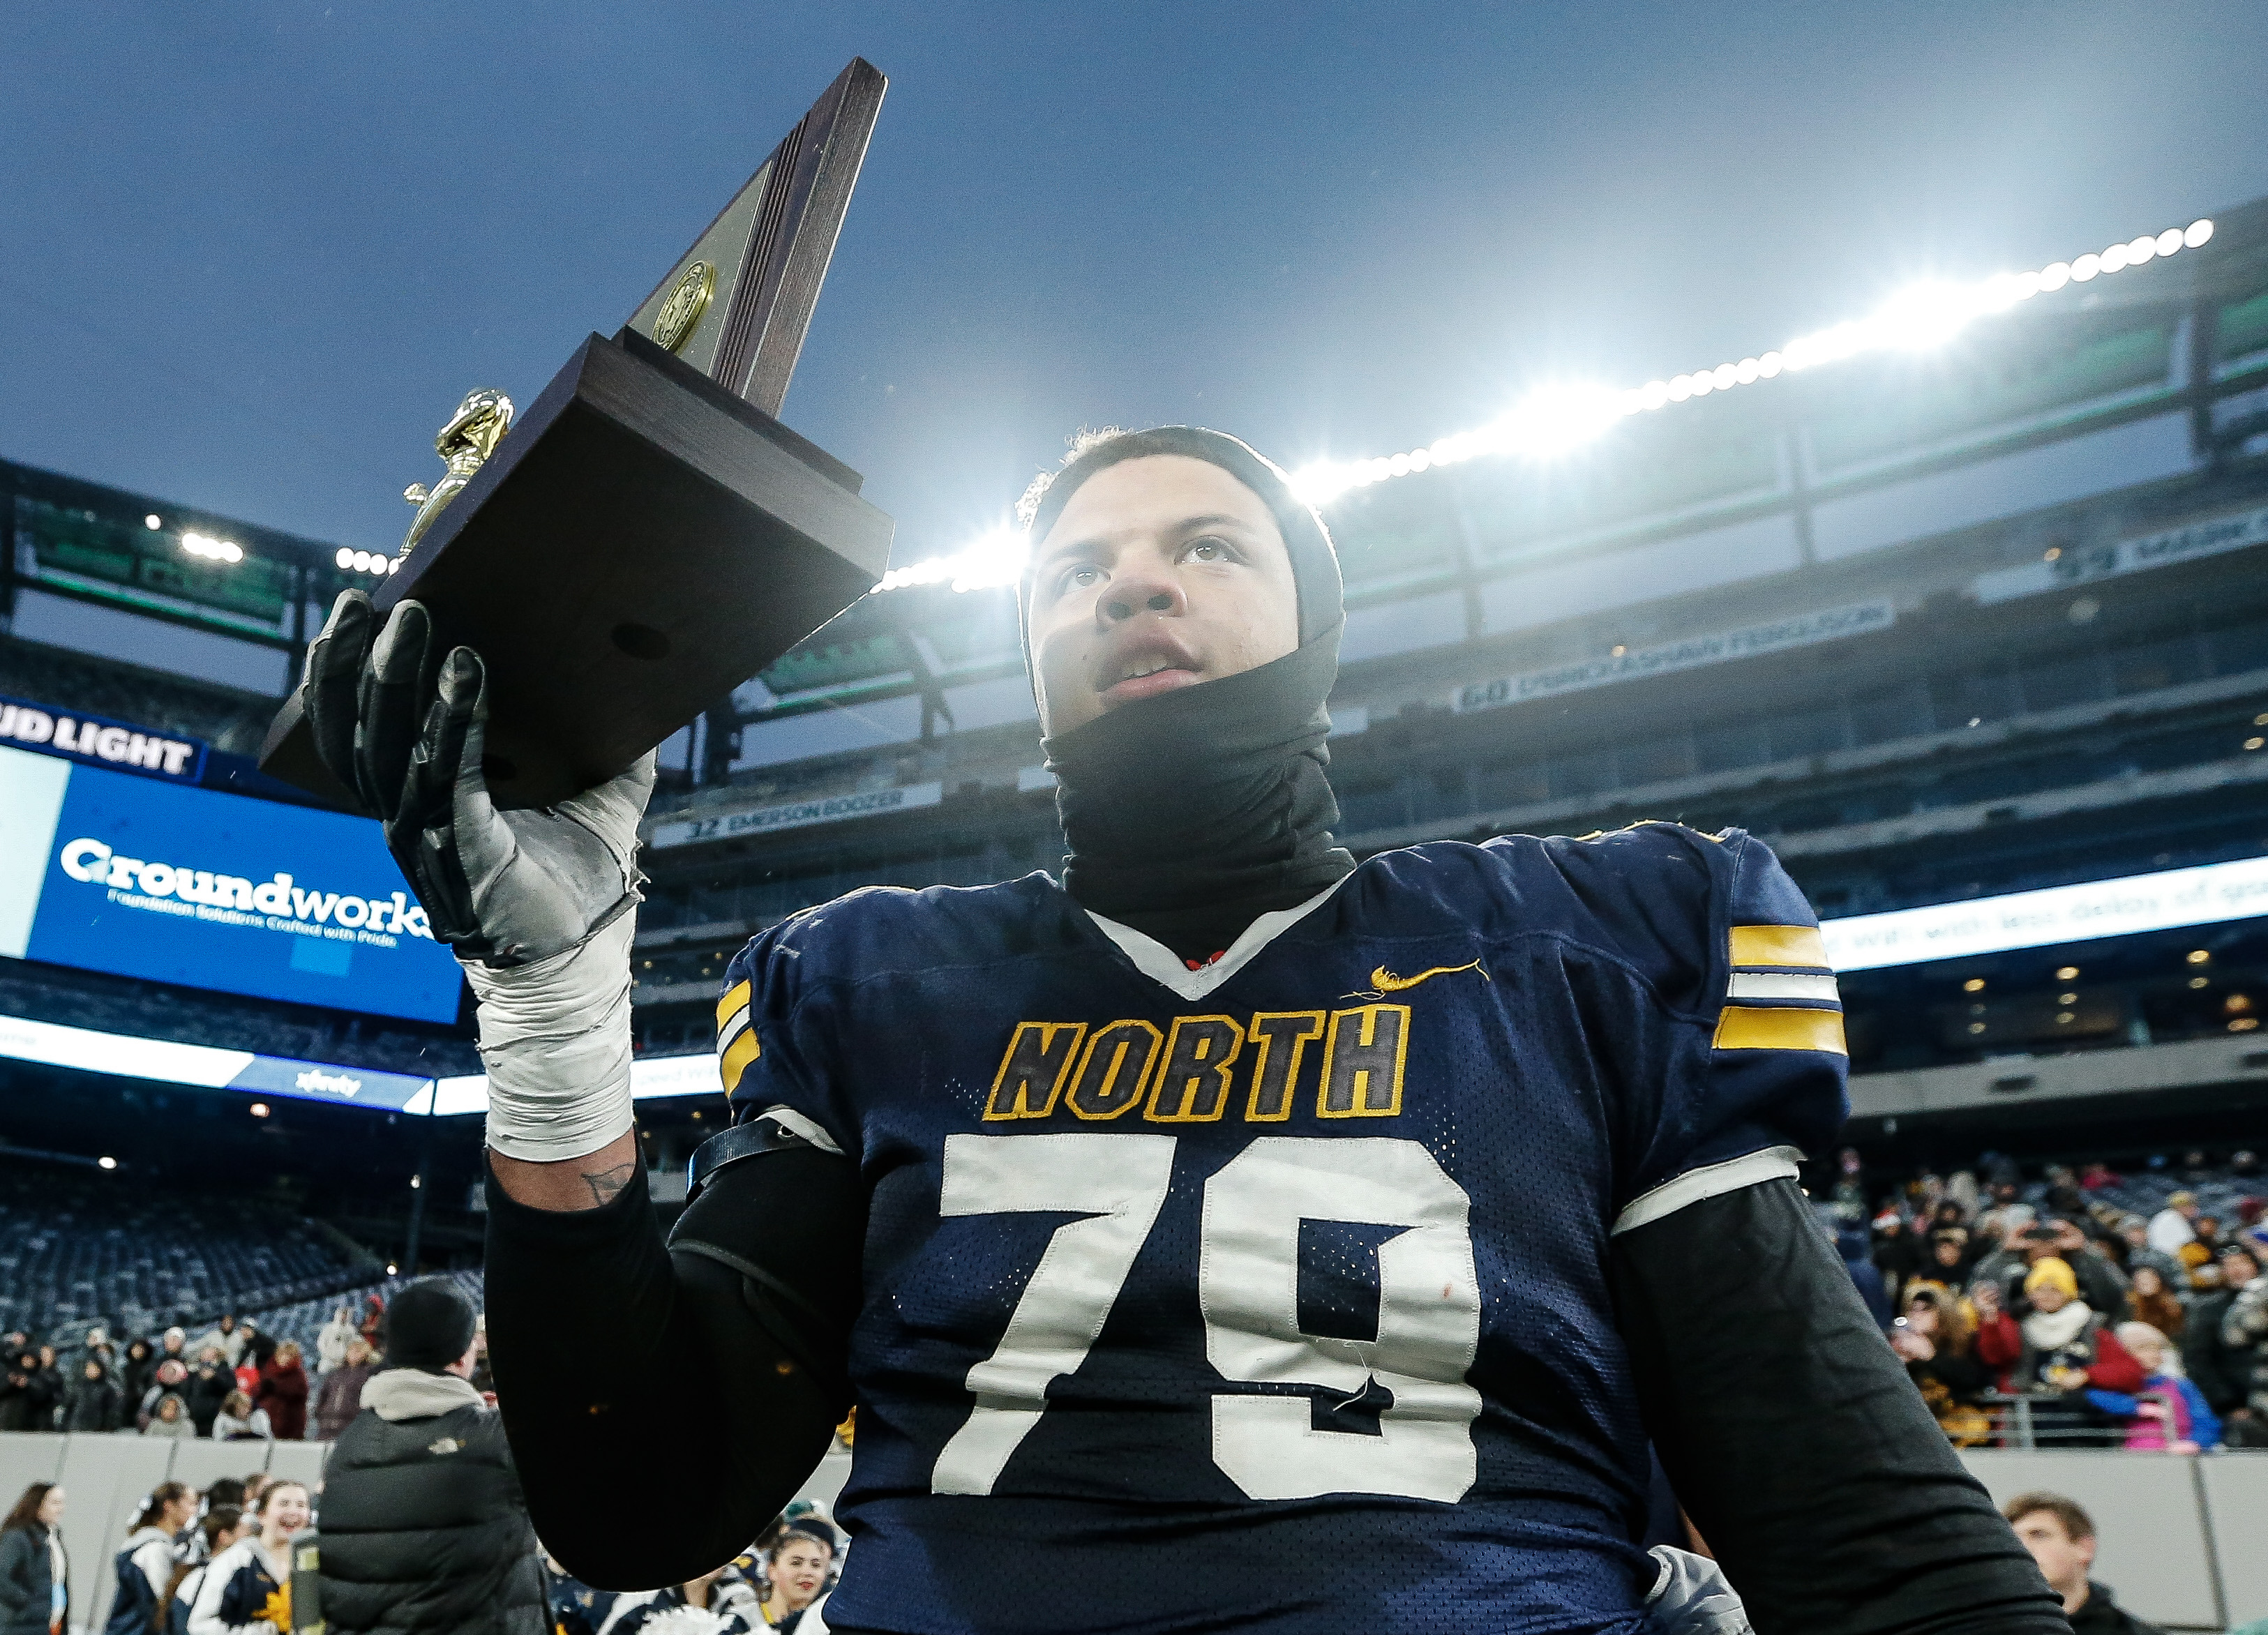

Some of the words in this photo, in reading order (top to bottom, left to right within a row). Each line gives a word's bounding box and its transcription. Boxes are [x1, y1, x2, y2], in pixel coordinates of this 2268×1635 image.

[52, 716, 193, 775] LIGHT
[982, 1003, 1411, 1122] NORTH
[931, 1133, 1482, 1505] 79
